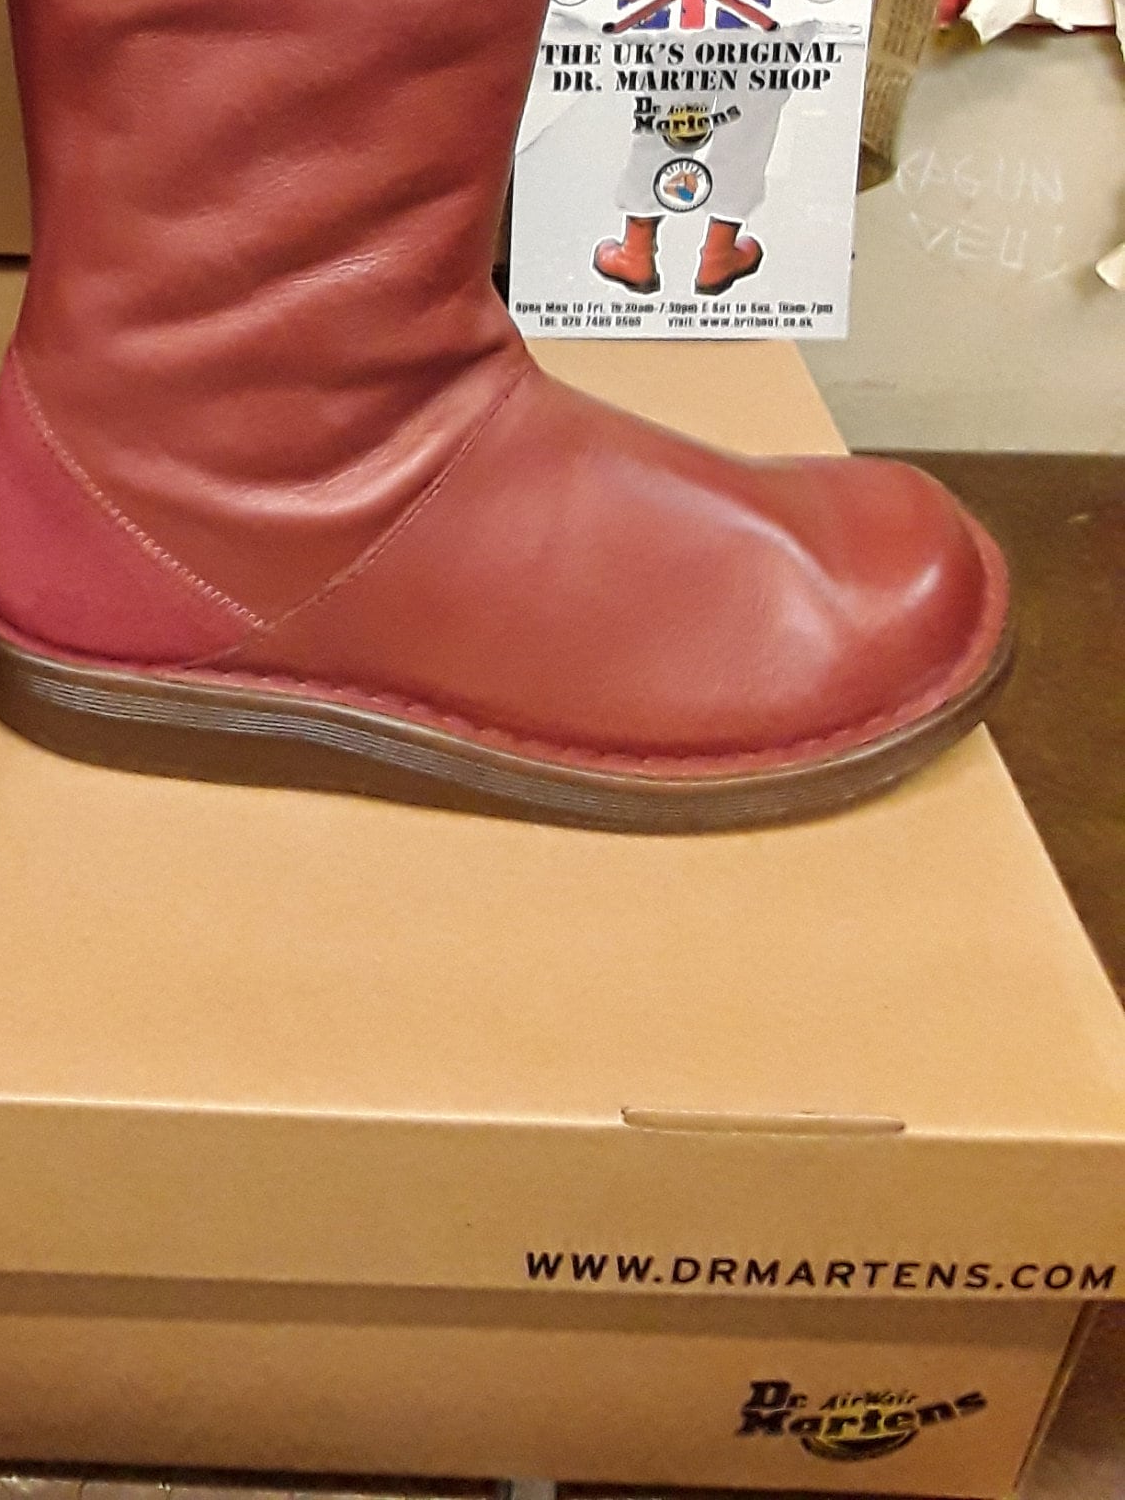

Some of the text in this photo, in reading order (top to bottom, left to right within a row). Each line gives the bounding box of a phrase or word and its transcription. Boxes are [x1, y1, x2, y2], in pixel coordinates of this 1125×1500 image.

[540, 42, 843, 66] THE UK'S ORIGINAL
[552, 68, 832, 92] DR. MARTEN SHOP
[631, 103, 742, 135] Martens
[515, 302, 542, 314] Open
[545, 302, 569, 313] Mon
[525, 1251, 1116, 1292] WWW.DRMARTENS.COM
[818, 1388, 918, 1411] AirWair
[735, 1390, 988, 1438] Martens
